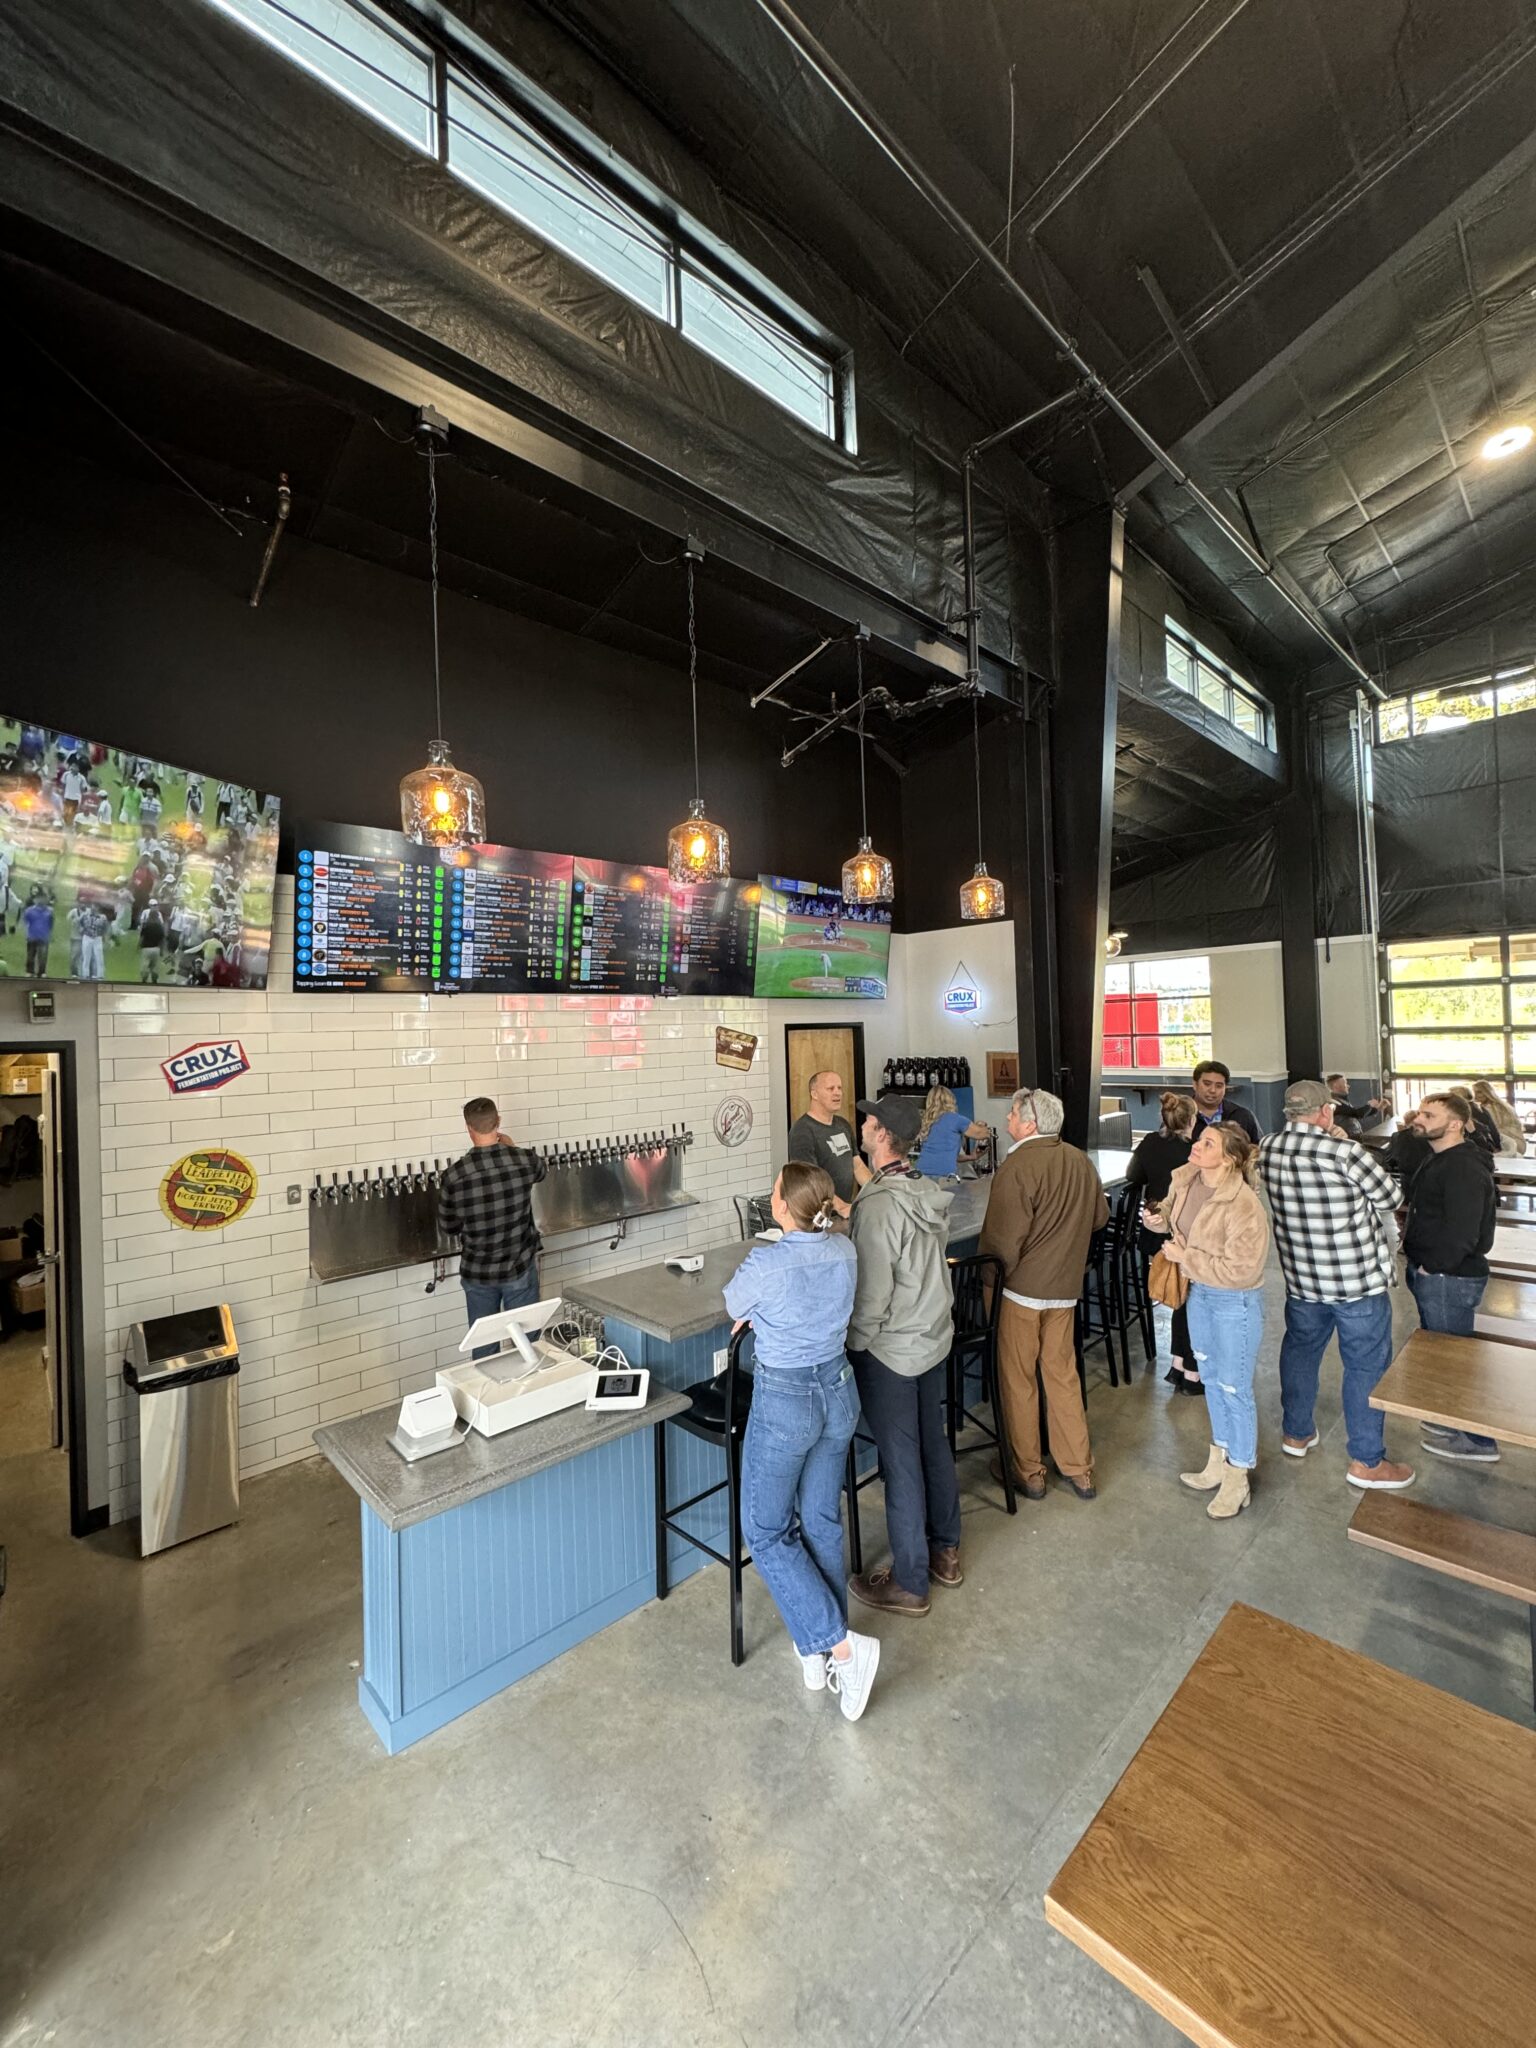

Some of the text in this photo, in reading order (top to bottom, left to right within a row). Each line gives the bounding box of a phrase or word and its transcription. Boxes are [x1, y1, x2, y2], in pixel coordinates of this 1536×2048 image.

[947, 992, 974, 1002] CRUX
[170, 1043, 238, 1077] CRUX
[177, 1062, 243, 1090] FERMENTATION PROJECT
[186, 1164, 249, 1180] LEADBETTER
[229, 1178, 248, 1190] RED
[177, 1191, 235, 1206] NORTH JETTY
[193, 1201, 233, 1213] BREWING
